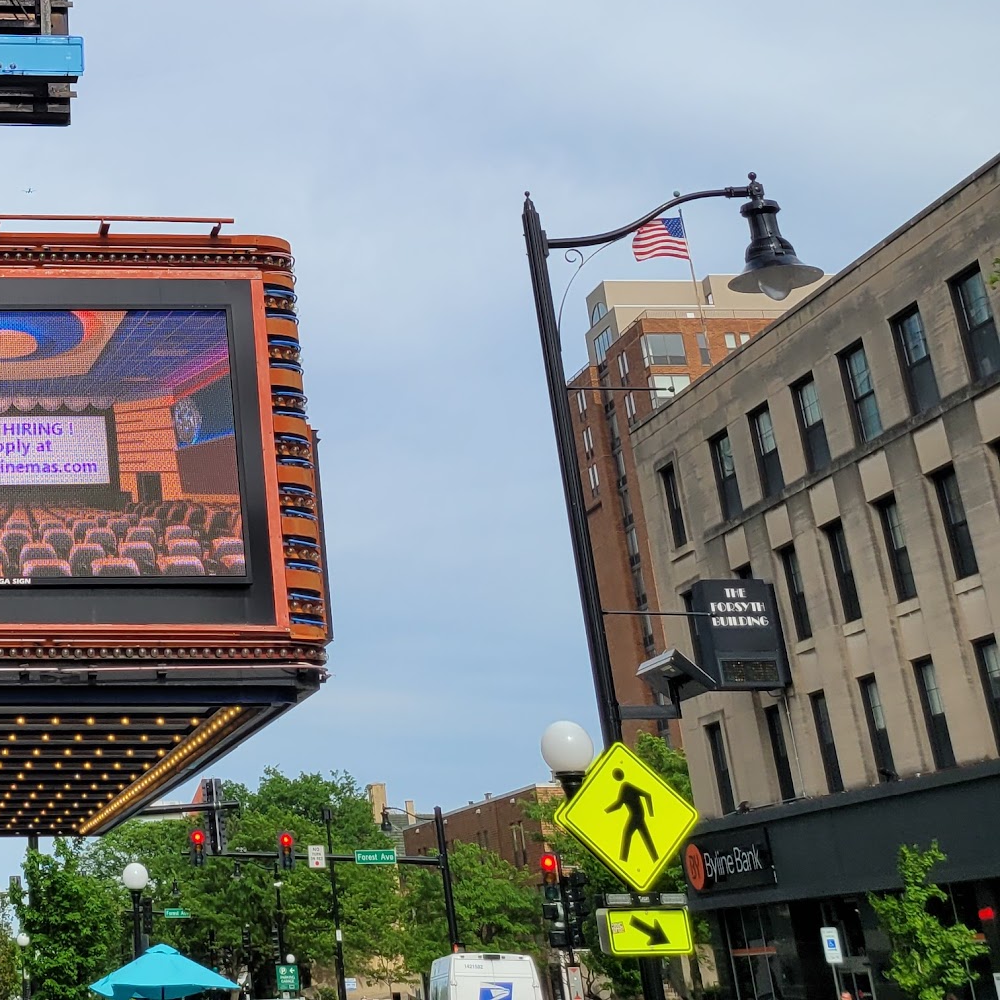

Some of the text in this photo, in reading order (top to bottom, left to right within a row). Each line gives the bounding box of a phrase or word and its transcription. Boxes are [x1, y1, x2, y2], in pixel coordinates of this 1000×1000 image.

[3, 422, 63, 436] HIRING
[36, 440, 53, 452] at
[723, 587, 747, 598] THE
[710, 602, 766, 612] FORSYTH
[712, 616, 769, 626] BUILDING
[357, 852, 394, 861] Forest Ave
[703, 850, 735, 883] Byline
[733, 843, 763, 873] Bank
